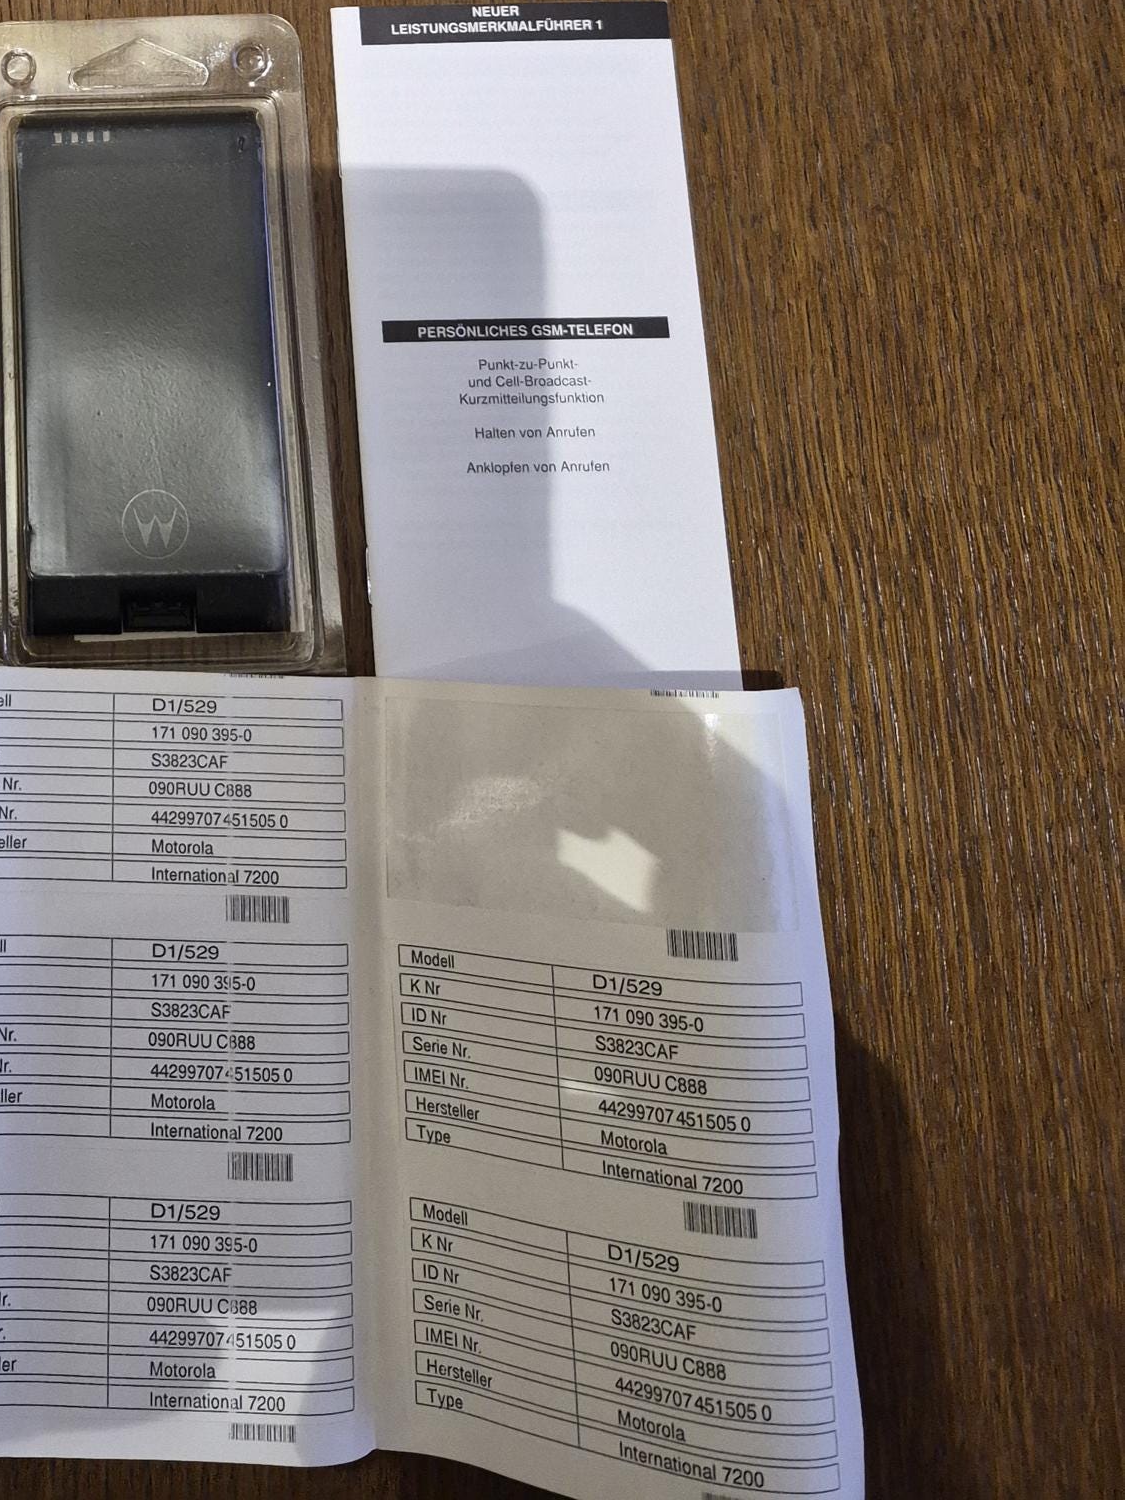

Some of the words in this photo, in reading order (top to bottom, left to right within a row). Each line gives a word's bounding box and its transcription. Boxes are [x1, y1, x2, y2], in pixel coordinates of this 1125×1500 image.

[472, 5, 519, 18] NEUER
[391, 18, 592, 35] LEISTUNGSMERKMALFÜHRER
[595, 20, 602, 30] 1
[418, 324, 528, 339] PERSÖNLICHES
[532, 324, 633, 336] GSM-TELEFON
[479, 358, 578, 370] Punkt-zu-Punkt-
[468, 377, 491, 387] und
[495, 375, 591, 387] Cell-Broadcast-
[459, 393, 604, 407] Kurzmitteilungsfunktion
[475, 427, 515, 439] Halten
[519, 429, 542, 438] von
[546, 426, 595, 438] Anrufen
[467, 462, 529, 475] Anklopfen
[533, 463, 556, 472] von
[561, 460, 610, 472] Anrufen
[152, 698, 217, 715] D1/529
[152, 726, 175, 739] 171
[182, 727, 207, 740] 090
[212, 728, 252, 742] 395-0
[151, 753, 229, 768] S3823CAF
[3, 778, 22, 791] Nr.
[149, 781, 210, 796] 090RUU
[0, 806, 17, 820] Nr.
[151, 839, 213, 855] Motorola
[151, 867, 239, 883] International
[244, 870, 279, 884] 7200
[411, 950, 454, 969] Modell
[410, 979, 420, 993] K
[425, 980, 440, 995] Nr
[593, 974, 662, 996] D1/529
[412, 1008, 426, 1022] ID
[431, 1010, 447, 1025] Nr
[595, 1006, 618, 1022] 171
[626, 1009, 653, 1026] 090
[659, 1013, 703, 1032] 395-0
[413, 1036, 448, 1055] Serie
[453, 1042, 471, 1059] Nr.
[595, 1035, 678, 1059] S3823CAF
[414, 1067, 445, 1080] IMEI
[450, 1073, 469, 1089] Nr.
[595, 1066, 660, 1089] 090RUU
[666, 1075, 707, 1095] C888
[416, 1096, 479, 1121] Hersteller
[416, 1124, 451, 1144] Type
[601, 1130, 667, 1155] Motorola
[603, 1160, 697, 1189] International
[703, 1176, 743, 1195] 7200
